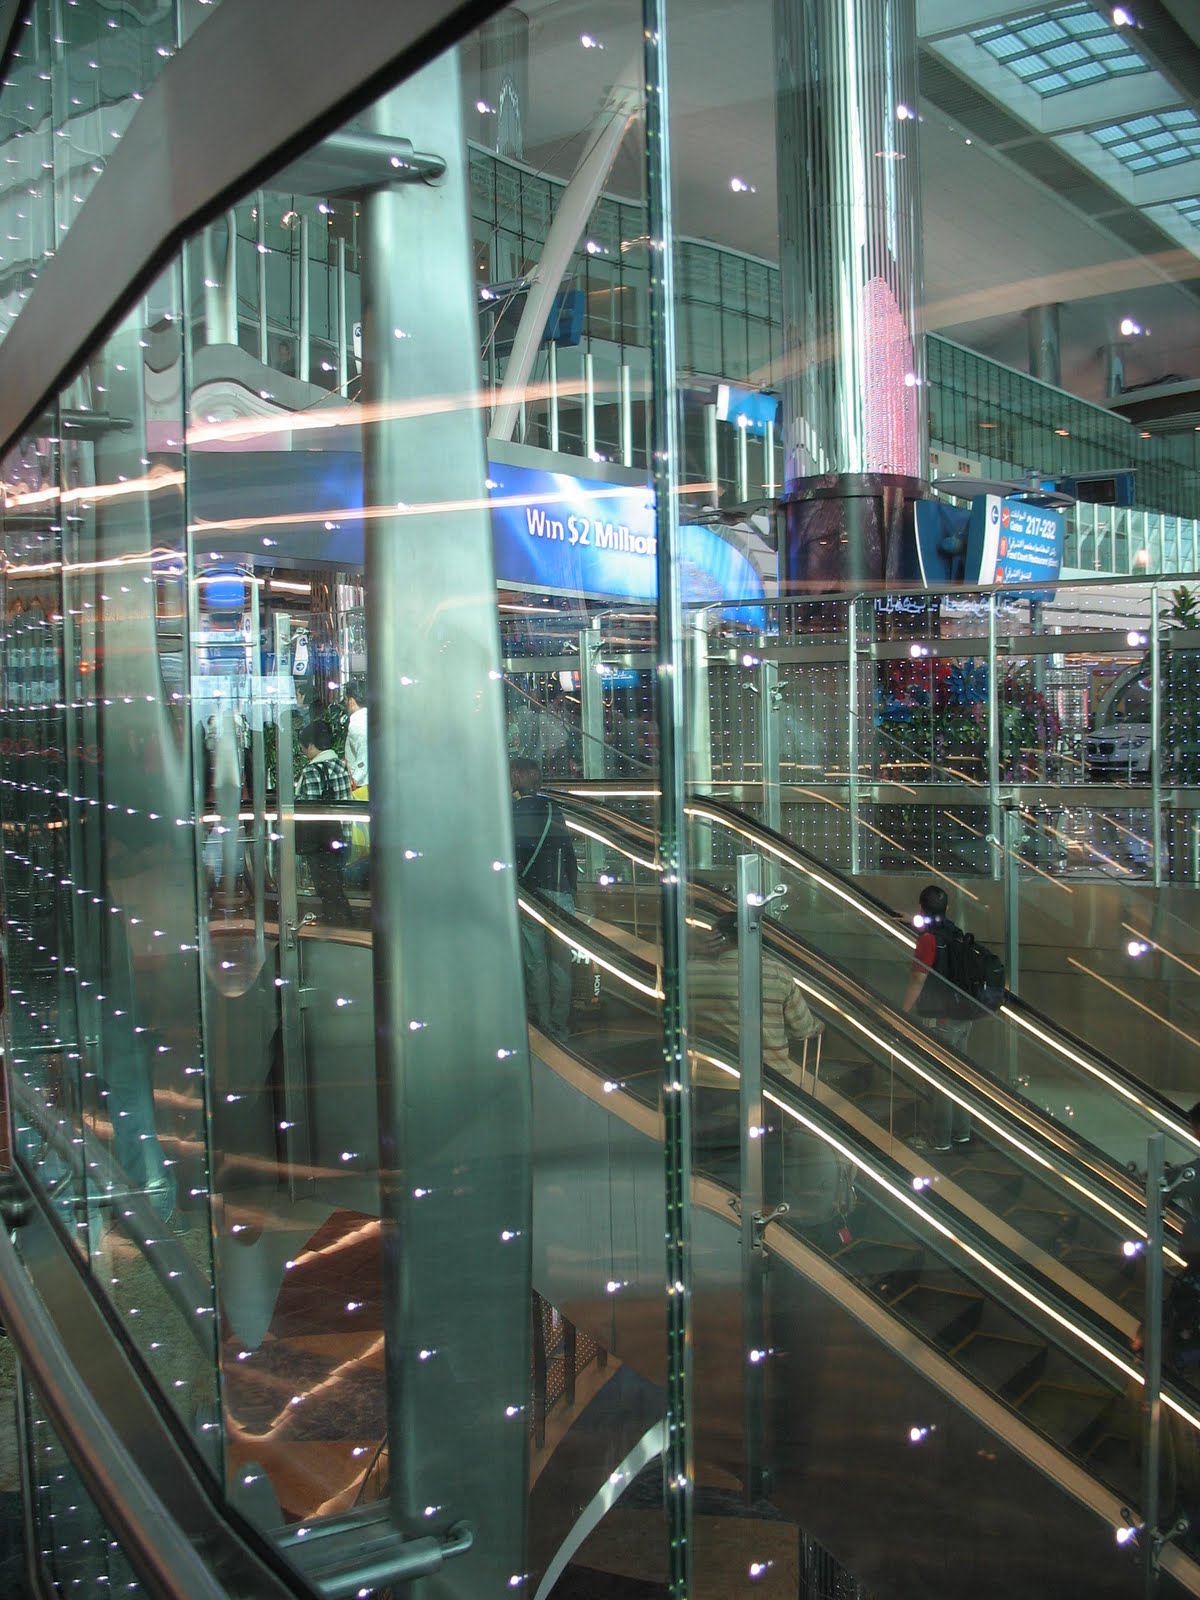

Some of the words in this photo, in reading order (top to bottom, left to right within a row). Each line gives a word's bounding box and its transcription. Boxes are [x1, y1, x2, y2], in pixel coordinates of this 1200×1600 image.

[526, 507, 565, 541] Win
[567, 514, 591, 546] $2
[594, 521, 657, 555] Million
[1026, 516, 1056, 540] 217-232
